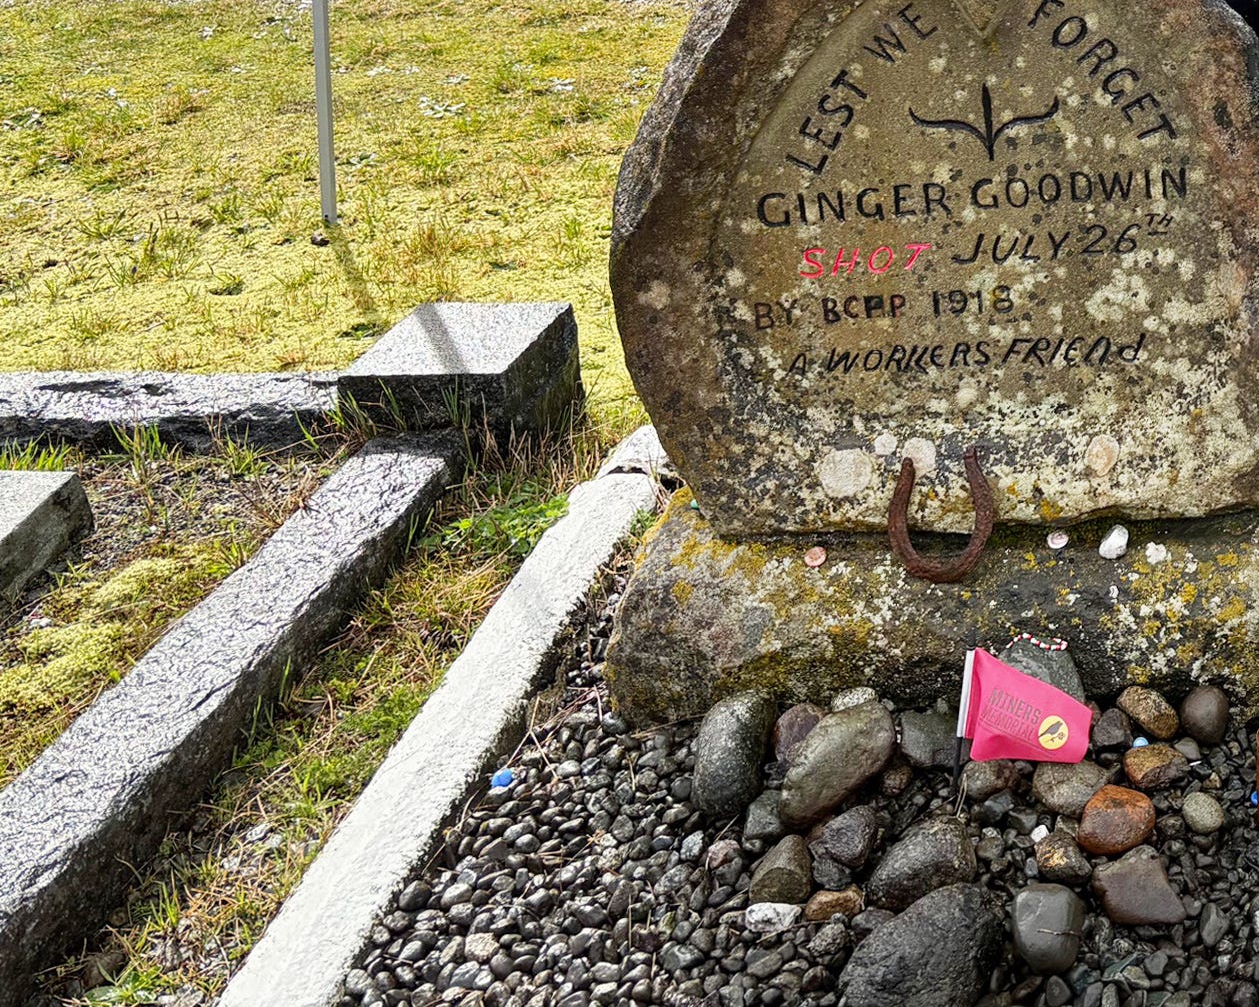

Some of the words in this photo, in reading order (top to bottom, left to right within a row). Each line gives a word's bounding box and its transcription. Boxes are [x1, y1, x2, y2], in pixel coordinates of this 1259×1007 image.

[785, 69, 868, 176] LEST
[863, 3, 938, 64] WE
[757, 183, 953, 228] GINGER
[970, 167, 1187, 211] GOODWIN
[800, 242, 932, 278] SHOT
[951, 231, 1071, 265] JULY
[754, 299, 798, 331] BY
[932, 285, 1014, 318] 1918
[786, 352, 808, 376] A
[982, 704, 1037, 742] MEMORIAL
[988, 687, 1042, 726] MINERS
